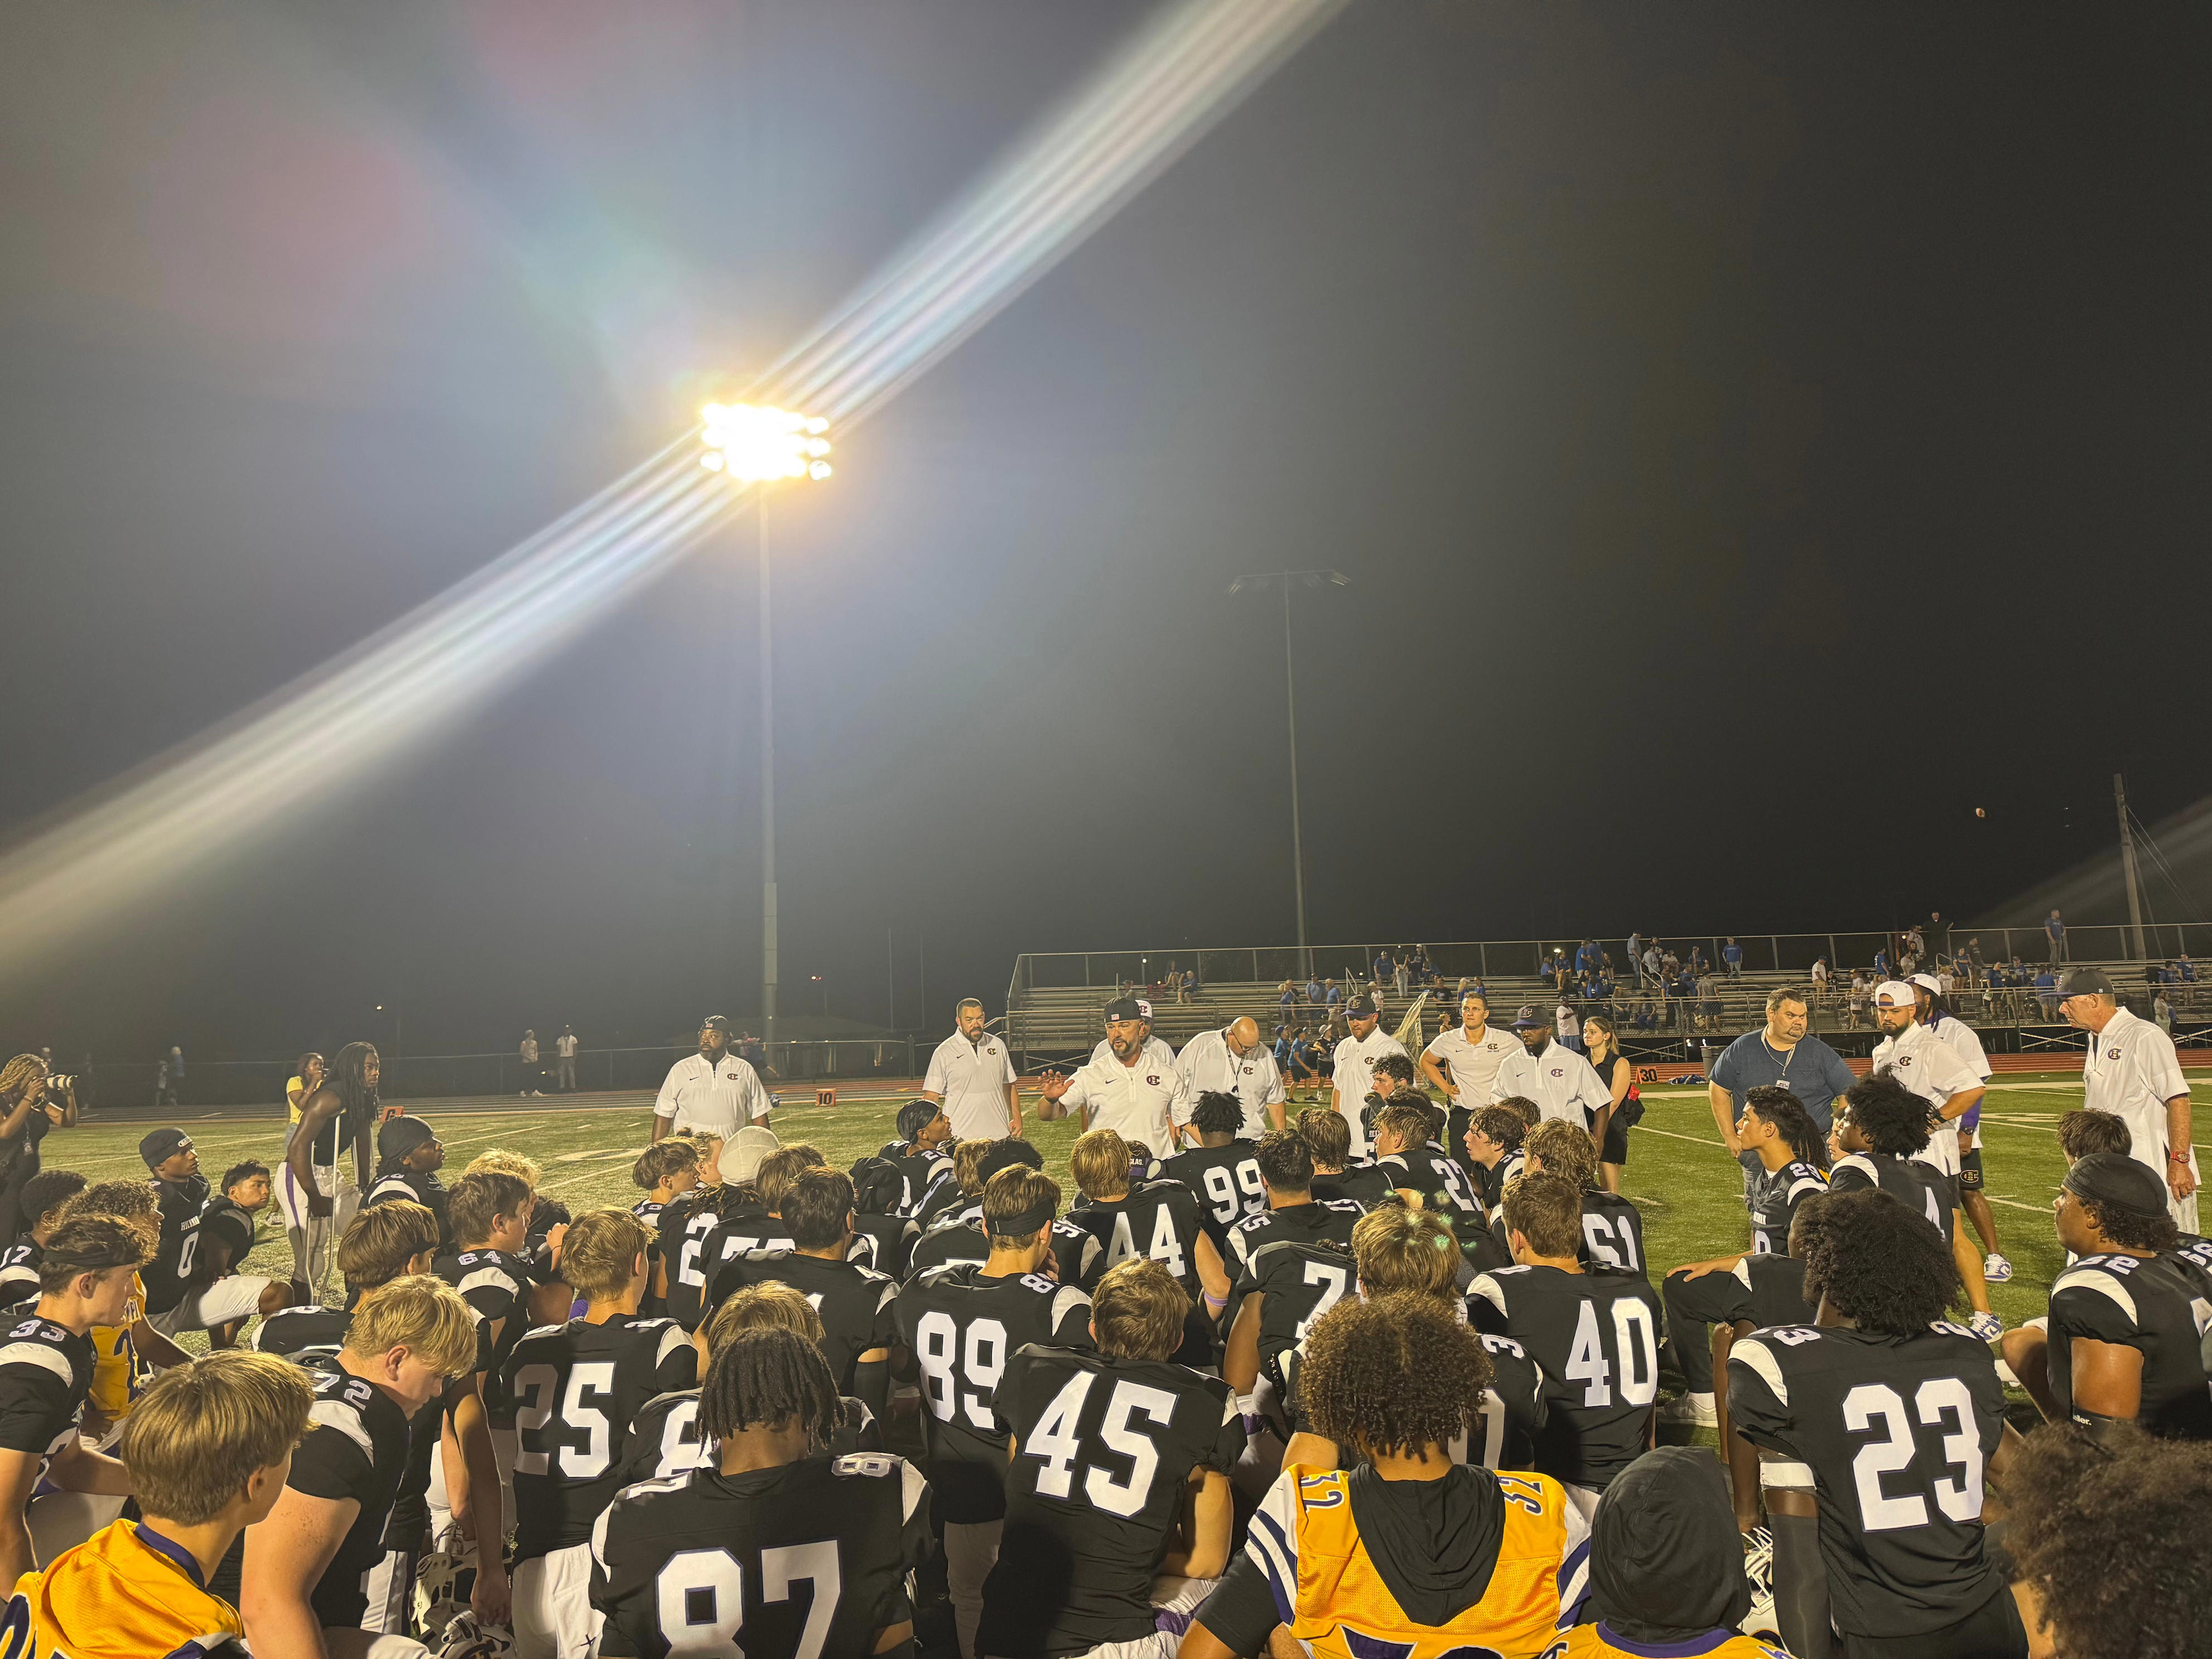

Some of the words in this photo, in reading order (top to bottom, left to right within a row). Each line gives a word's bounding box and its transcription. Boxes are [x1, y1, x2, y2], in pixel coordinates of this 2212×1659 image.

[818, 1092, 833, 1105] 10
[1638, 1068, 1659, 1083] 30
[1203, 1158, 1267, 1224] 99
[1789, 1162, 1823, 1181] 29
[177, 1231, 199, 1279] 0
[457, 1250, 502, 1266] 64
[1106, 1202, 1186, 1278] 44
[8, 1319, 66, 1342] 33
[1565, 1297, 1659, 1408] 40
[312, 1372, 373, 1411] 72
[916, 1310, 1008, 1430] 89
[514, 1361, 616, 1479] 25
[1023, 1369, 1180, 1518] 45
[1842, 1377, 1984, 1533] 23
[655, 1539, 844, 1659] 87
